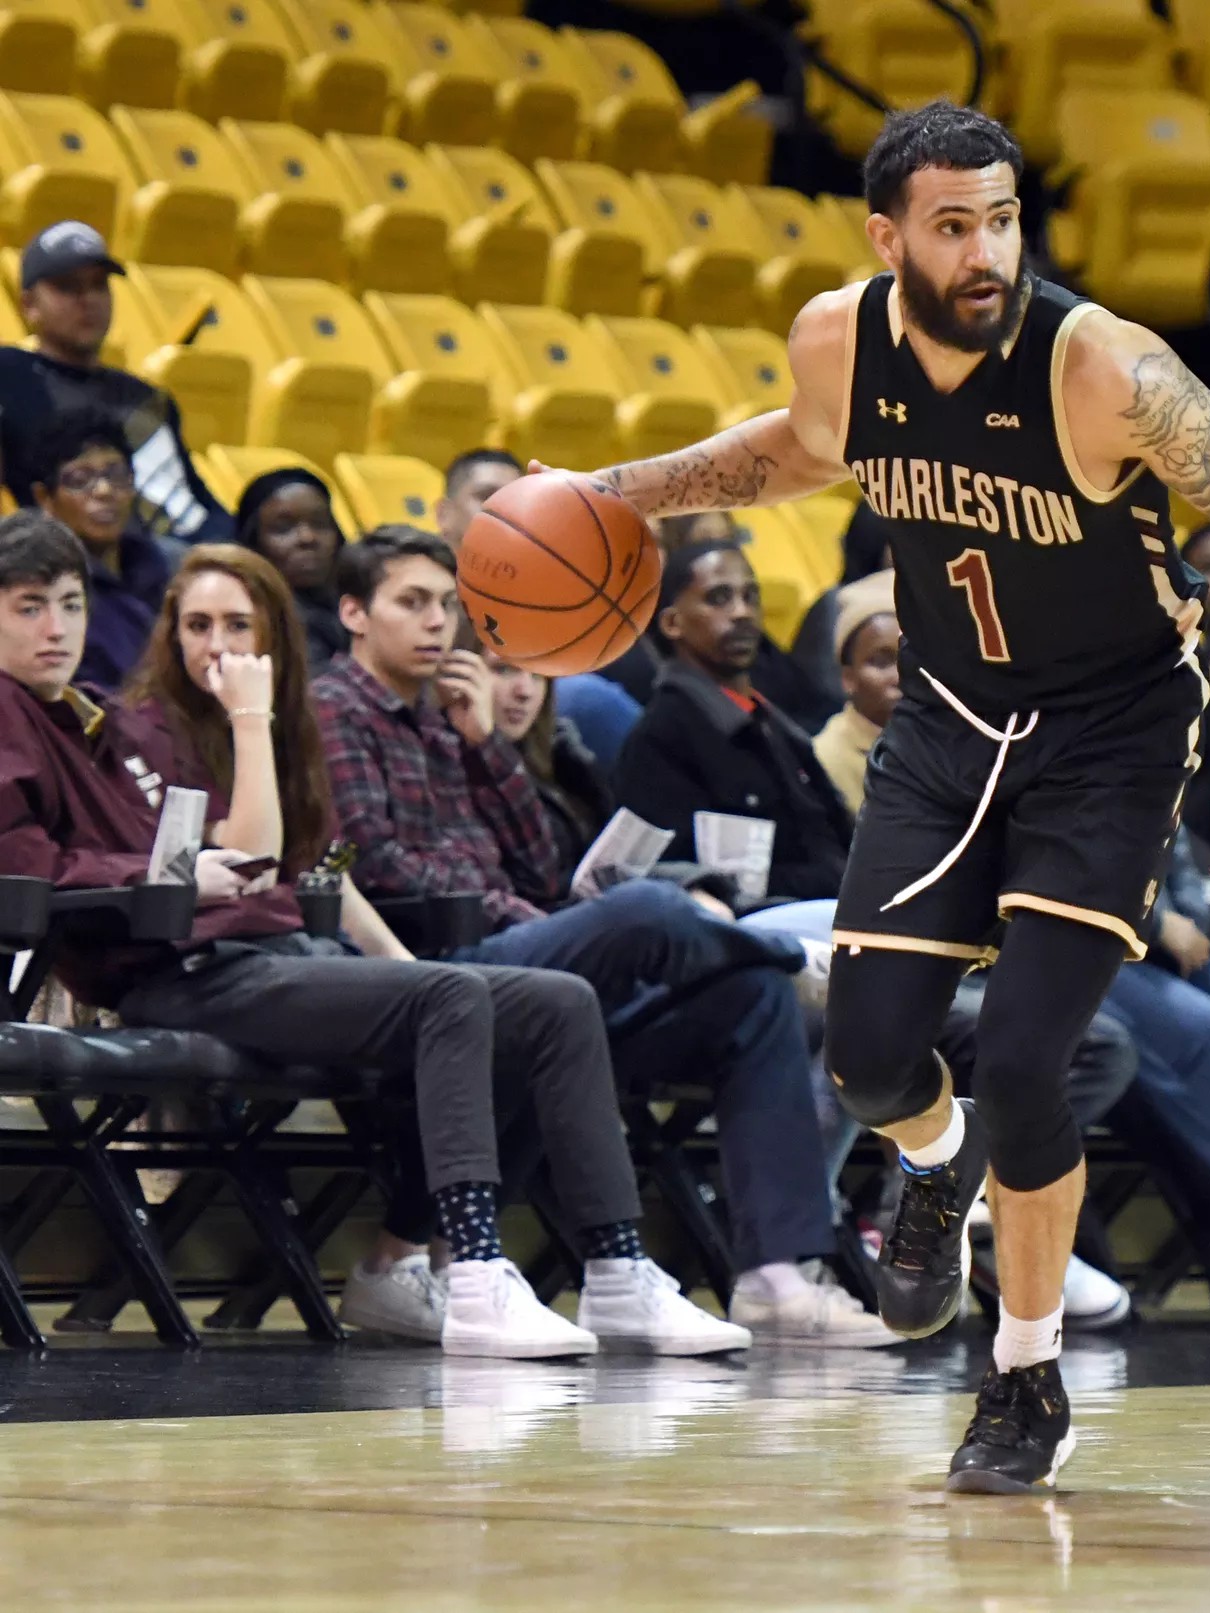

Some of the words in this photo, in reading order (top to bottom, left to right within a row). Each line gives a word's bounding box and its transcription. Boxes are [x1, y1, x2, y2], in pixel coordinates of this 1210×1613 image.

[985, 412, 1020, 428] CAA
[851, 456, 1084, 545] CHARLESTON
[946, 548, 1012, 662] 1
